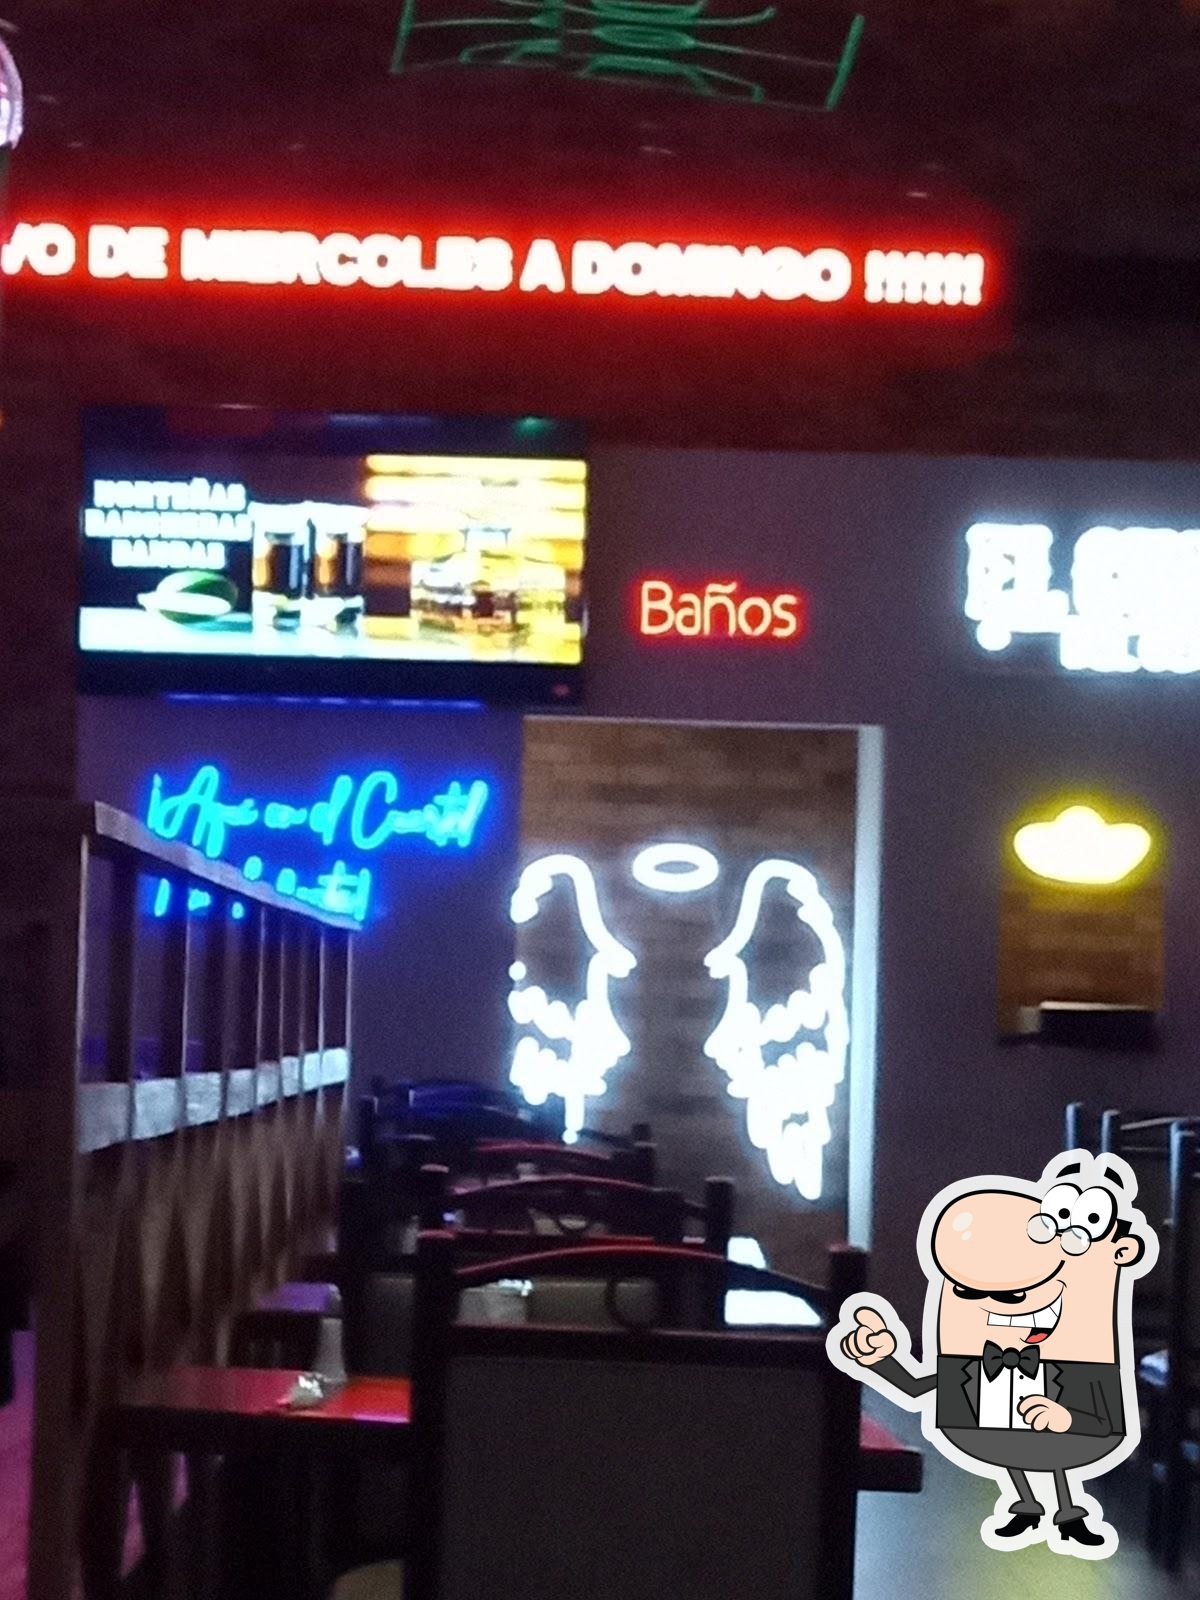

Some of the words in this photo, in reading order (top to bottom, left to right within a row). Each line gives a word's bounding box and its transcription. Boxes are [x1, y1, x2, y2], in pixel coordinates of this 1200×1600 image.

[88, 224, 169, 279] DE
[519, 238, 566, 293] A
[572, 240, 852, 301] DOMINGO
[640, 580, 797, 638] Baños
